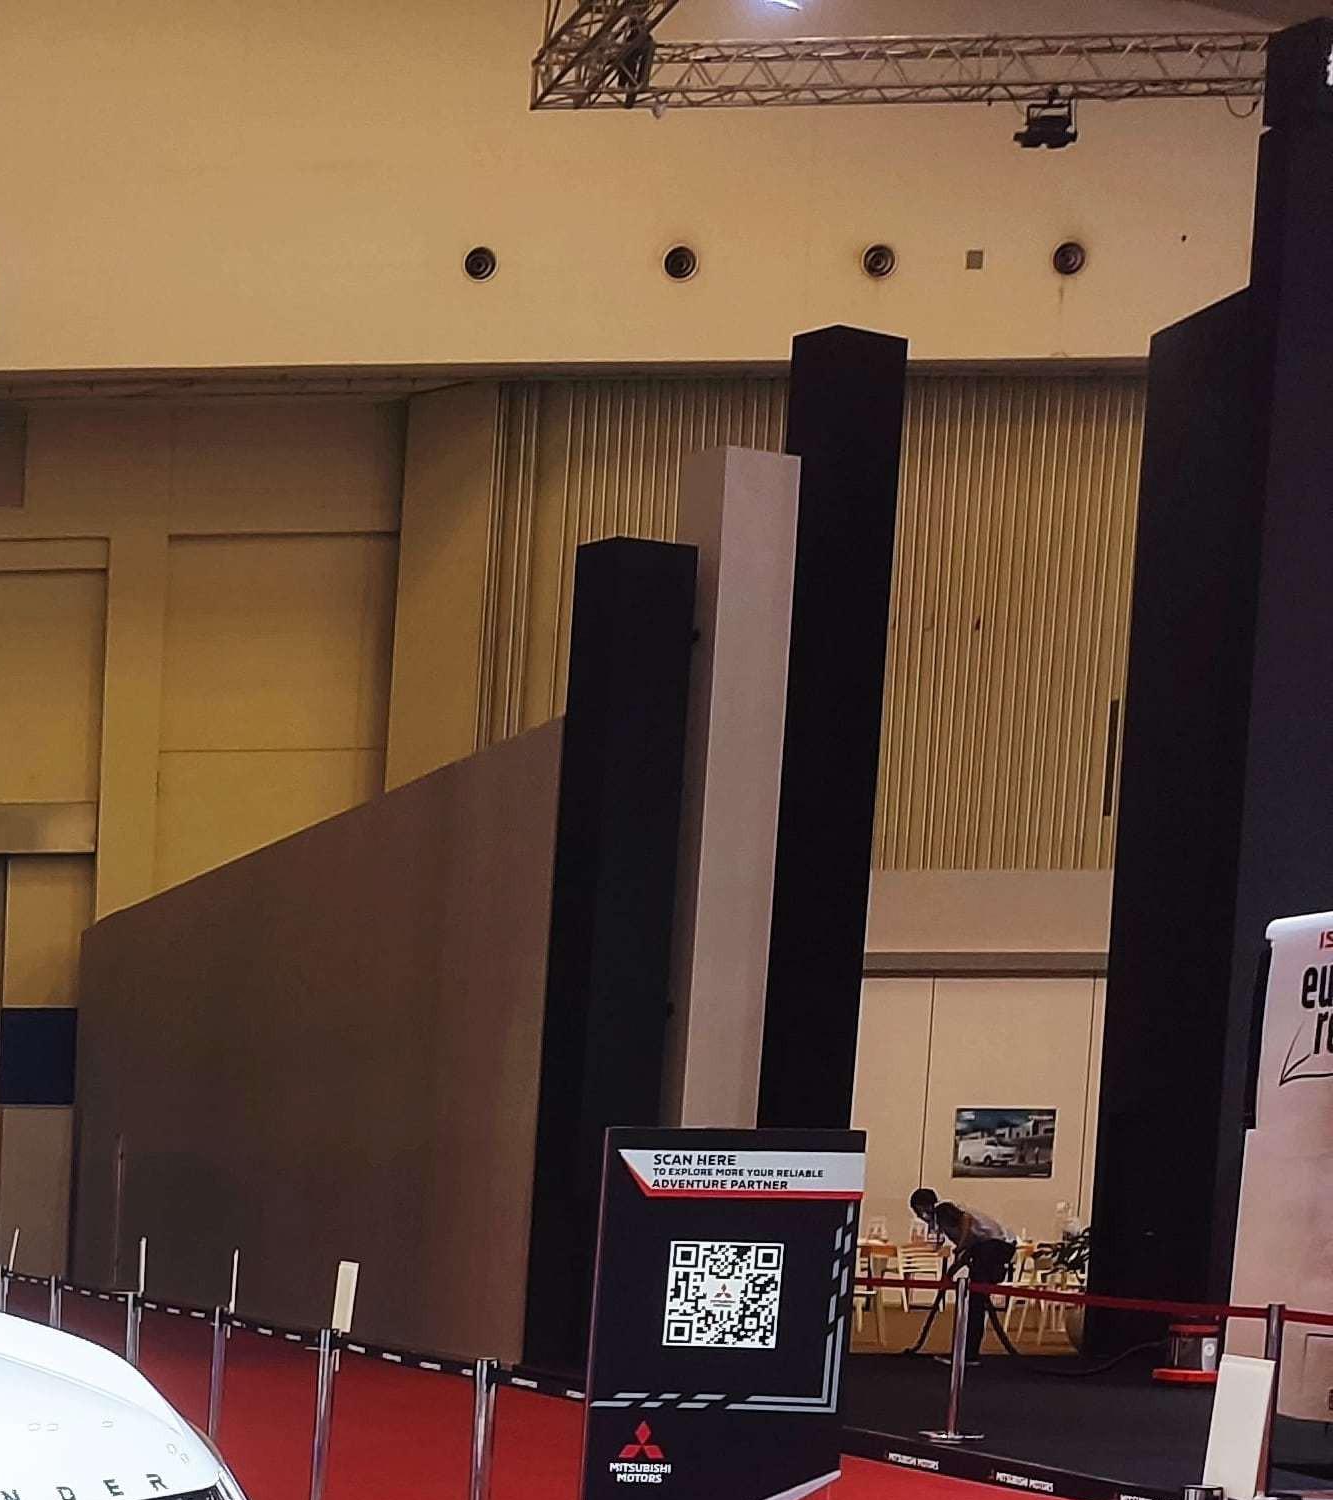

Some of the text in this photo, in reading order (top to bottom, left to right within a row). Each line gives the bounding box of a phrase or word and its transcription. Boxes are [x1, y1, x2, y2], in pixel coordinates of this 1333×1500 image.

[653, 1153, 738, 1167] SCAN HERE
[653, 1167, 824, 1178] TO EXPLORE MORE YOUR RELIABLE
[652, 1179, 789, 1190] ADVENTURE PARTNER
[609, 1462, 672, 1474] MITSUBISHI
[616, 1473, 663, 1483] MOTORS
